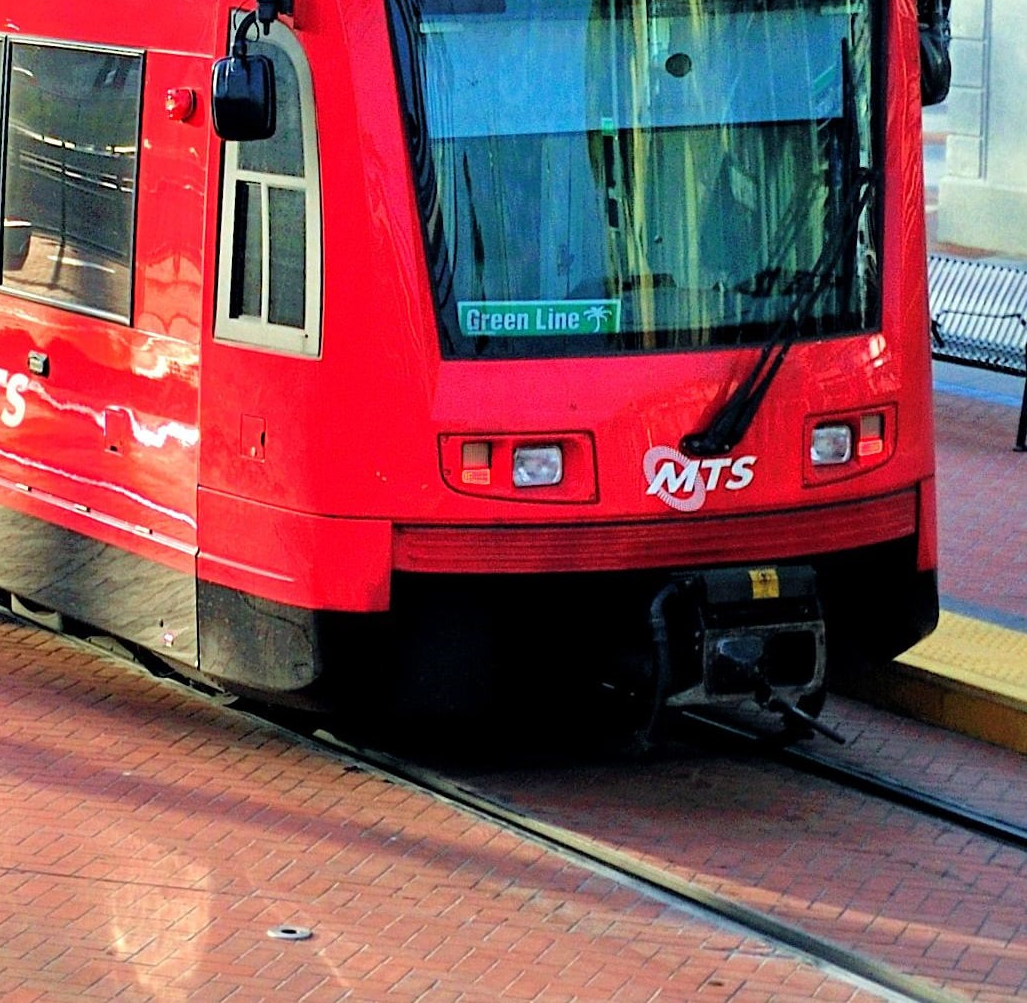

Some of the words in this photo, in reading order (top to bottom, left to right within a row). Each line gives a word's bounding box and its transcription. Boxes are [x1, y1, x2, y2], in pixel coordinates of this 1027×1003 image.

[466, 308, 529, 331] Green
[535, 308, 580, 331] Line
[646, 455, 758, 495] MTS
